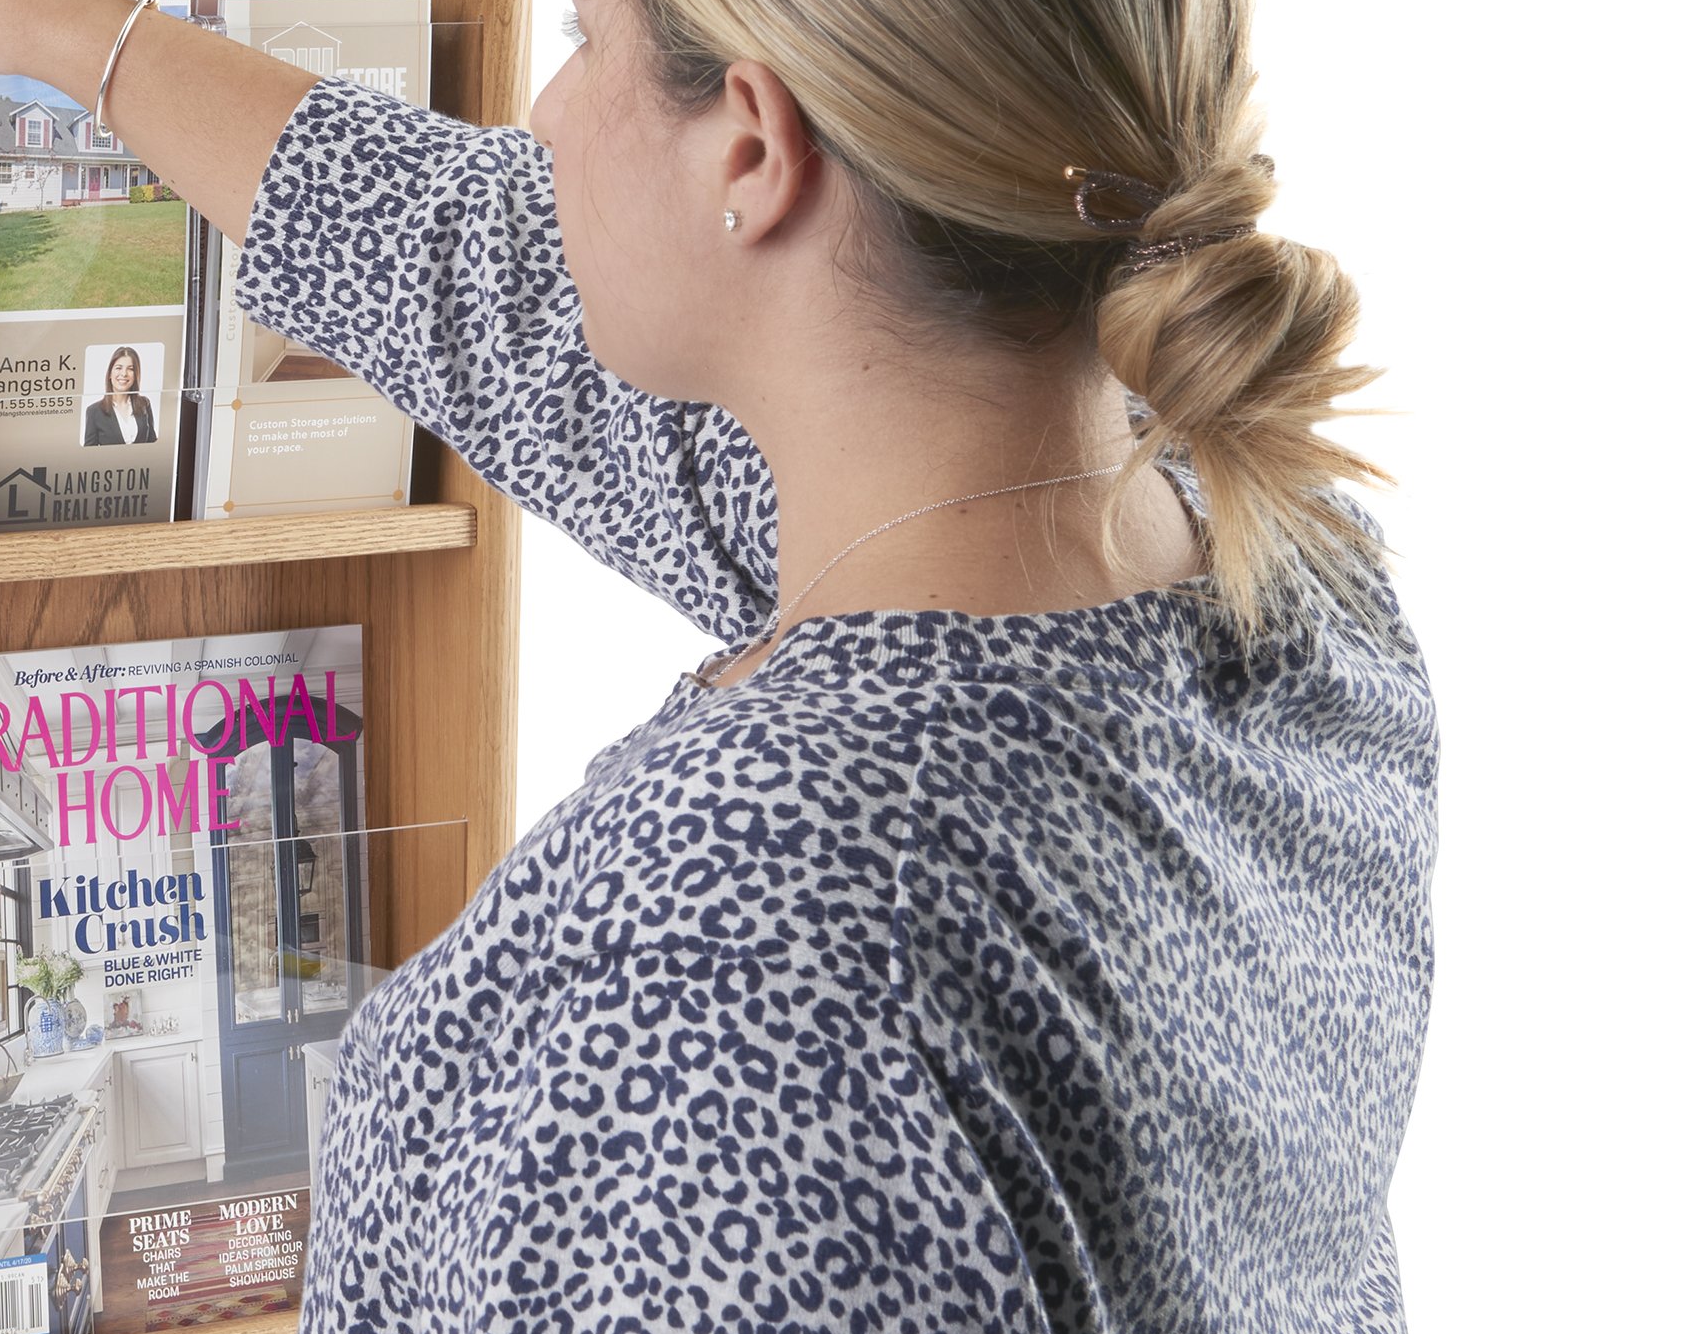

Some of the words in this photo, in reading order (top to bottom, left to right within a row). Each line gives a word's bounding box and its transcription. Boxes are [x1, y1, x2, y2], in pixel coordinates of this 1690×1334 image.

[0, 357, 51, 374] Anna
[59, 355, 77, 371] K.
[249, 419, 288, 430] Custom
[291, 417, 330, 430] Storage
[332, 414, 377, 426] solutions
[54, 468, 150, 496] LANGSTON
[52, 498, 89, 523] REAL
[95, 494, 148, 520] ESTATE
[14, 667, 64, 688] Before
[65, 667, 79, 681] &
[79, 664, 127, 684] After:
[128, 662, 182, 676] REVIVING
[184, 662, 193, 671] A
[194, 657, 242, 670] SPANISH
[244, 653, 299, 666] COLONIAL
[58, 756, 240, 847] HOME
[38, 869, 206, 919] Kitchen
[75, 901, 208, 954] Crush
[105, 956, 140, 972] BLUE
[143, 955, 154, 967] &
[156, 949, 202, 965] WHITE
[105, 973, 144, 987] DONE
[148, 966, 194, 982] RIGHT!
[219, 1193, 298, 1220] MODERN
[129, 1210, 191, 1234] PRIME
[235, 1214, 284, 1236] LOVE
[133, 1229, 190, 1252] SEATS
